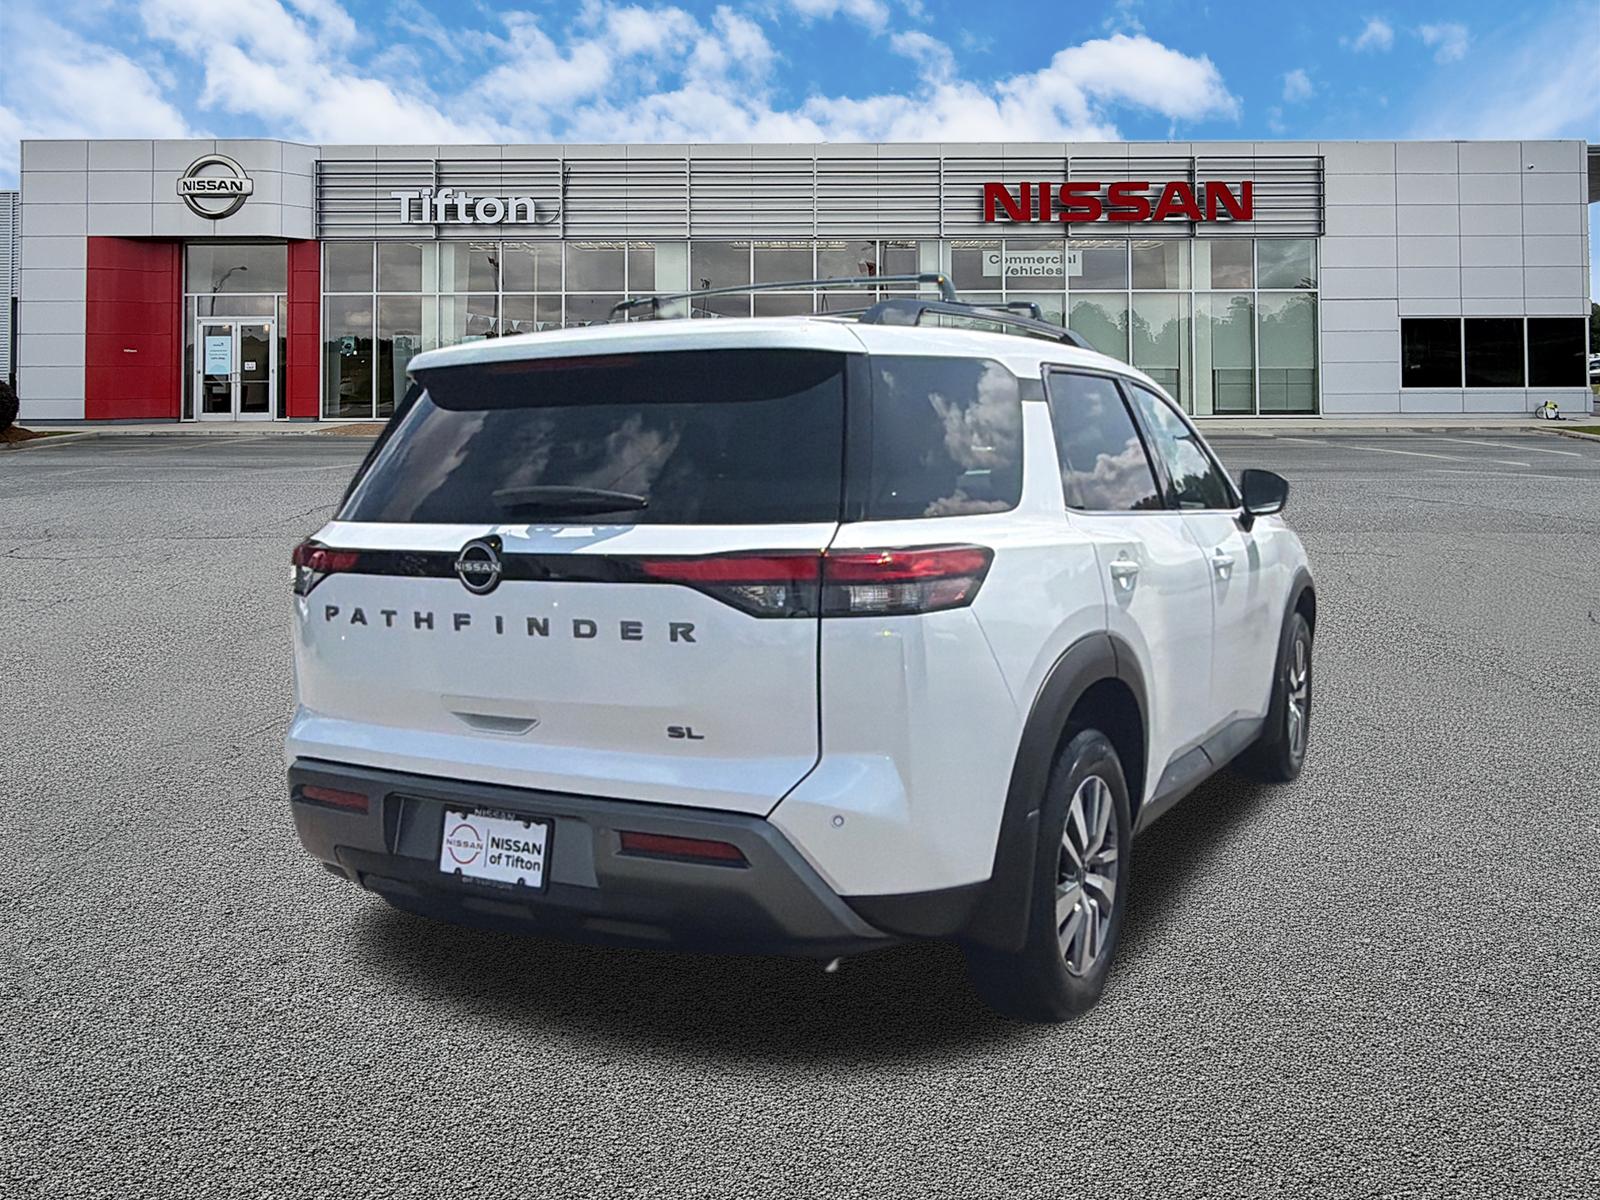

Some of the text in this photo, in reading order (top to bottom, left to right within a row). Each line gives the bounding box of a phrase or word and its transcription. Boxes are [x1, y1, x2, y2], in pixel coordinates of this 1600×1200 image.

[183, 180, 243, 192] NISSAN
[391, 188, 536, 224] Tifton
[983, 181, 1253, 223] NISSAN
[454, 561, 502, 573] NISSAN
[325, 605, 697, 643] PATHFINDER
[667, 726, 705, 740] SL
[446, 838, 483, 850] NISSAN
[490, 836, 542, 856] NISSAN
[489, 853, 541, 872] of Tifton
